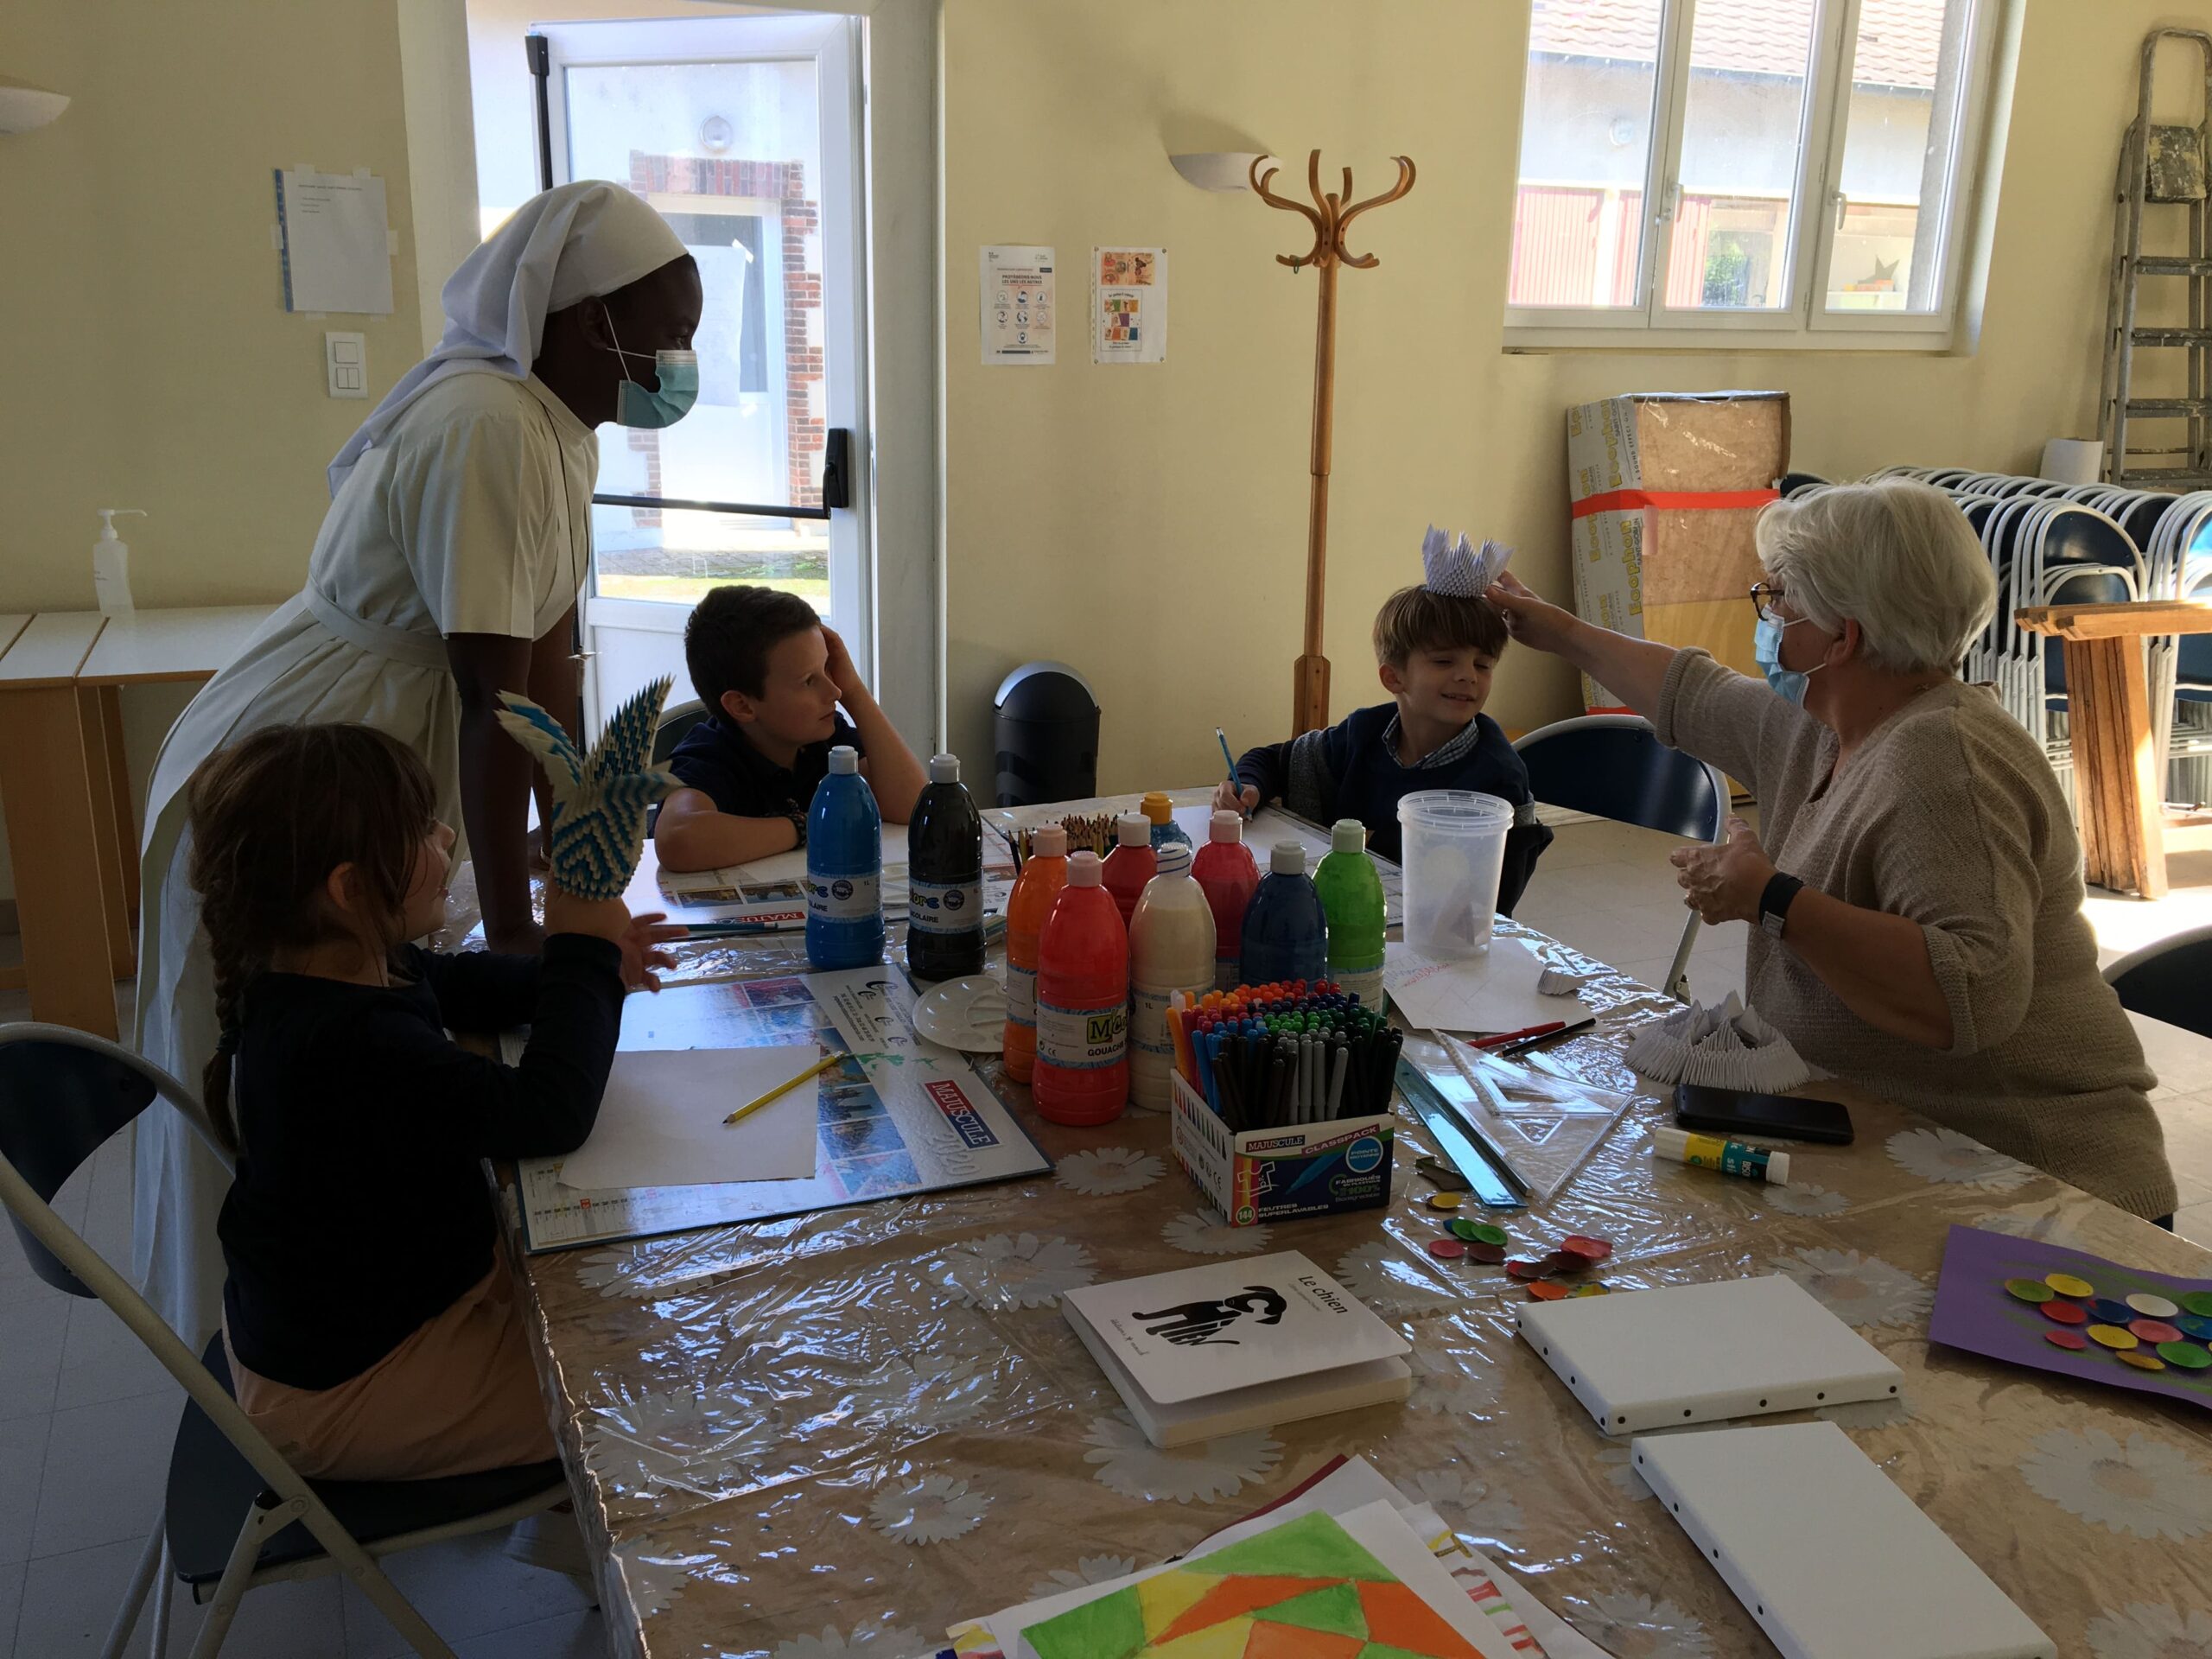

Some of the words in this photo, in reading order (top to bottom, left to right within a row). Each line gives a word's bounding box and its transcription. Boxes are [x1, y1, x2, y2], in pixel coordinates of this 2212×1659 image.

[1620, 520, 1643, 616] Ecophon
[931, 1083, 991, 1146] MAJUSCULE
[1247, 1136, 1305, 1152] MAJUSCULE
[1304, 1126, 1379, 1155] CLASSPACK
[1238, 1210, 1253, 1221] 144
[1258, 1202, 1299, 1212] FEUTRES
[1258, 1204, 1330, 1218] SUPERLAVABLES
[1297, 1274, 1312, 1288] Le
[1312, 1284, 1349, 1315] chien
